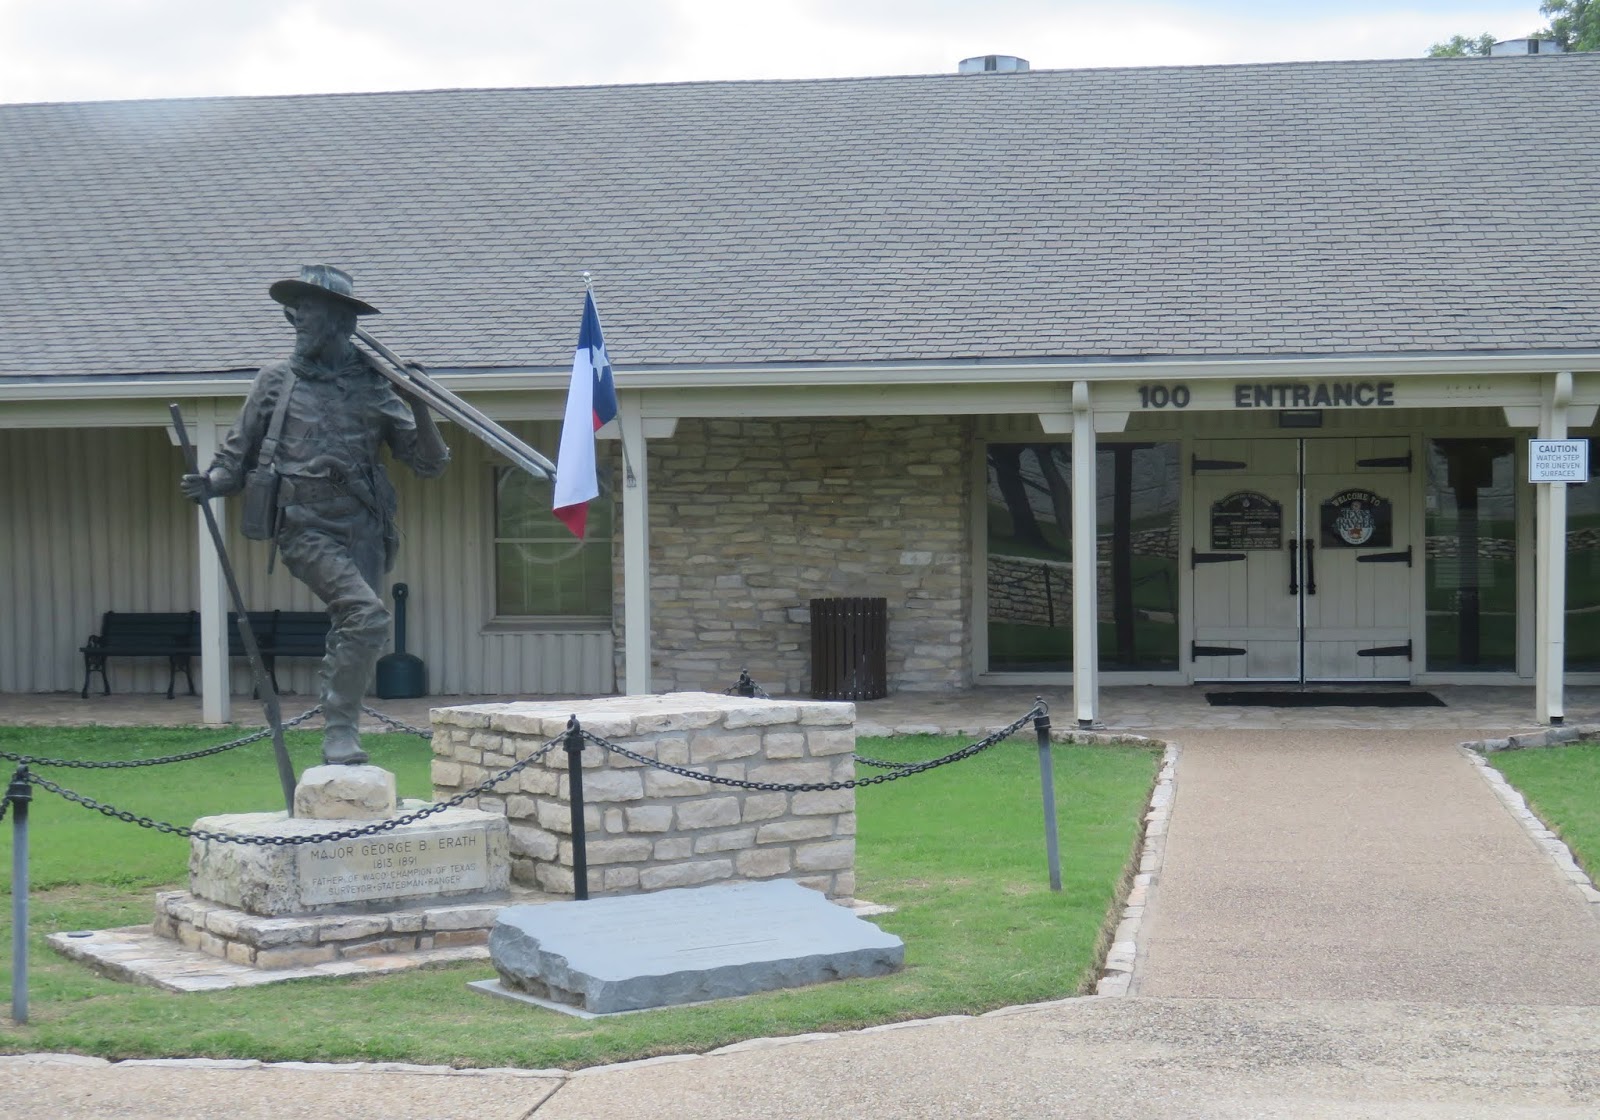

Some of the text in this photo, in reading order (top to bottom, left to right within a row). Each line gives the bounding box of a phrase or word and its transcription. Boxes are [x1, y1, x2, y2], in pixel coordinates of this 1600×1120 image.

[1138, 382, 1395, 408] 100 ENTRANCE
[1538, 445, 1578, 453] CAUTION
[1331, 492, 1381, 507] WELCOME TO
[1340, 508, 1371, 520] TEXAS
[310, 846, 354, 860] MAJOR
[361, 841, 412, 856] GEORGE
[438, 836, 476, 850] ERATH
[373, 856, 417, 869] 1813 1891
[312, 863, 477, 886] FATHER OF WACO CHAMPION OF TEXAS
